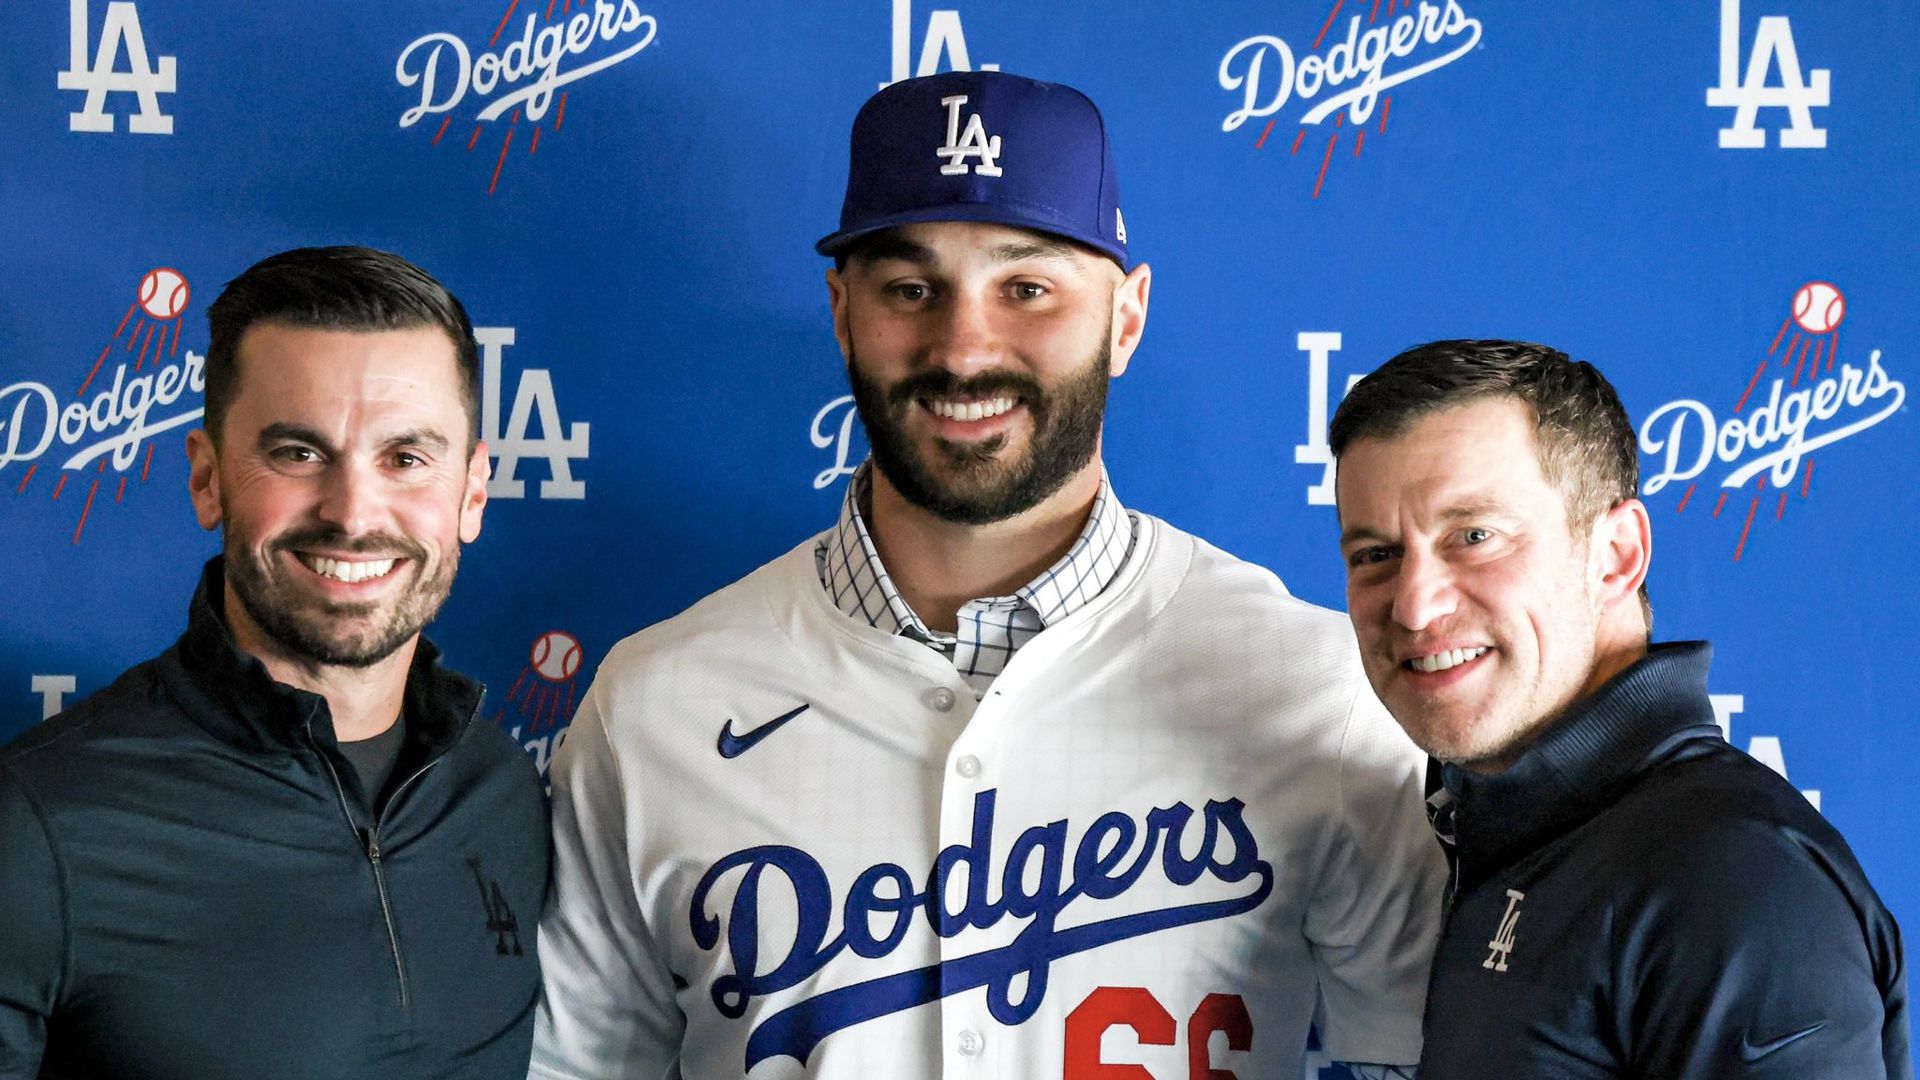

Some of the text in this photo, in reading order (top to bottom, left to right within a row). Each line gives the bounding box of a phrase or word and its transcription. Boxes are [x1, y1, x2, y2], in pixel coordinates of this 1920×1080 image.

[58, 0, 177, 134] LA
[396, 0, 656, 128] Dodgers
[1219, 0, 1482, 132] Dodgers
[1706, 0, 1830, 148] LA
[936, 95, 1003, 178] LA
[0, 350, 205, 471] Dodger
[476, 327, 590, 499] LA
[1295, 332, 1355, 505] L
[1640, 350, 1905, 495] Dodgers
[690, 788, 1273, 1074] Dodgers
[1482, 888, 1524, 973] LA
